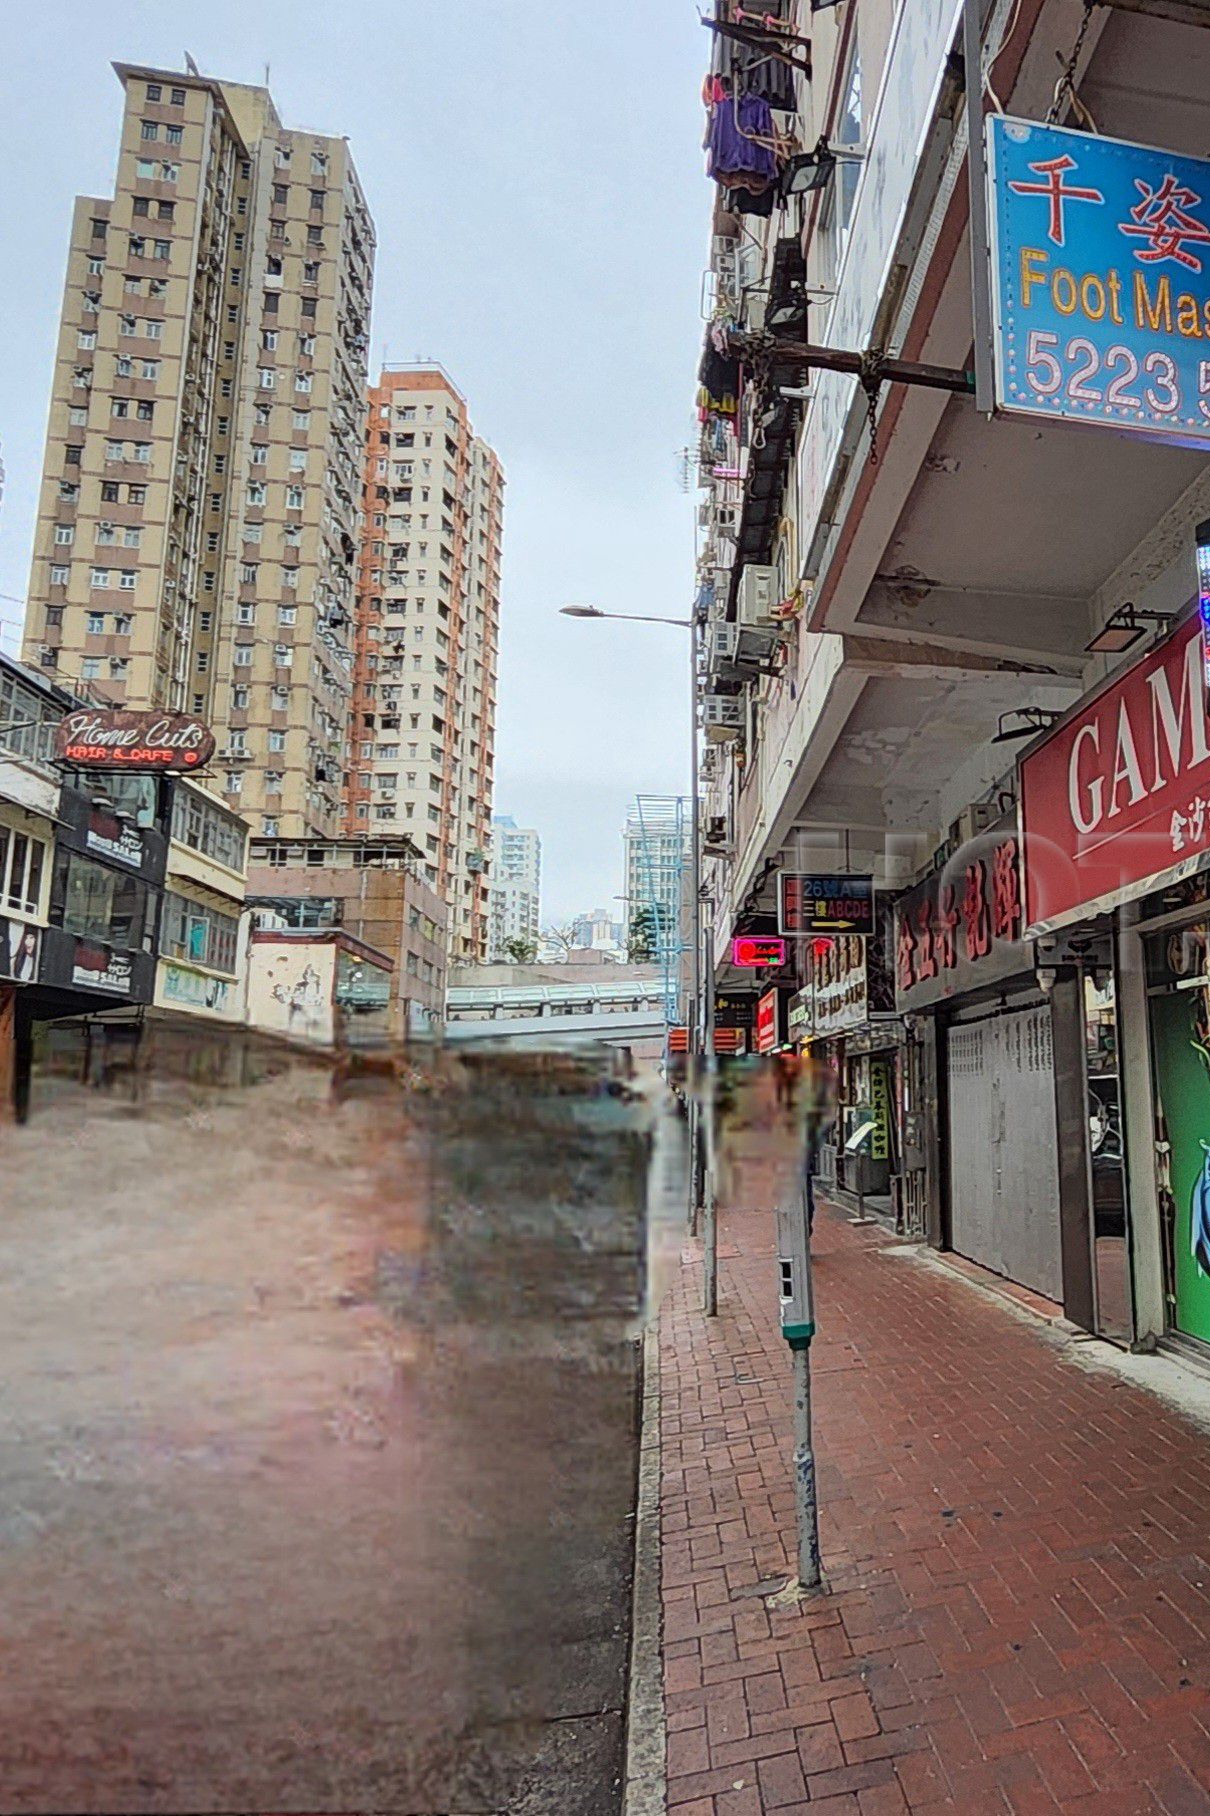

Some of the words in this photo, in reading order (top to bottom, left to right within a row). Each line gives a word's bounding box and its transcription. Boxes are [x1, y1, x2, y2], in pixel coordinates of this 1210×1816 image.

[1020, 247, 1124, 326] Foot
[1025, 330, 1180, 414] 5223
[66, 714, 141, 747] Home
[145, 719, 203, 749] Cuts
[66, 745, 106, 759] HAIR
